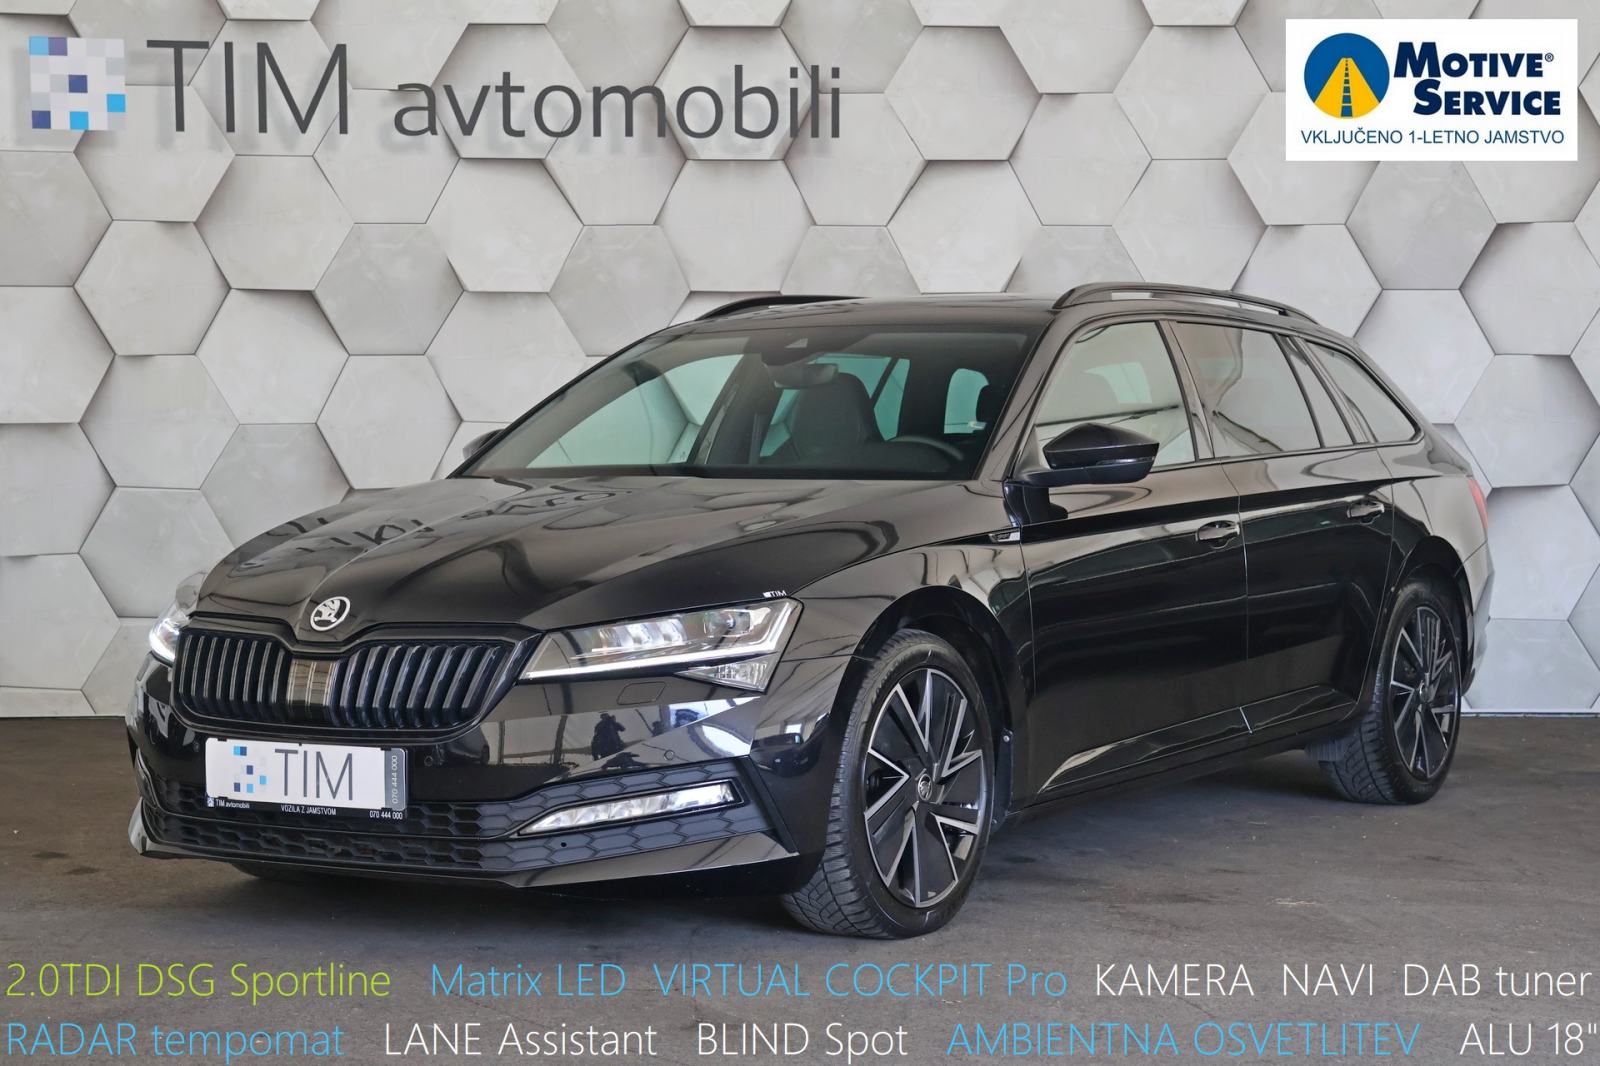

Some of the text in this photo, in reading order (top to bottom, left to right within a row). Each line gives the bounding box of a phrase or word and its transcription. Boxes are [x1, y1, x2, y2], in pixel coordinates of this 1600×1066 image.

[147, 39, 842, 140] TIM avtomobili
[275, 748, 353, 801] TIM
[216, 799, 225, 807] TIM
[281, 804, 301, 814] VOZILA
[306, 806, 337, 816] JAMSTVOM
[369, 810, 403, 820] 070 444 000
